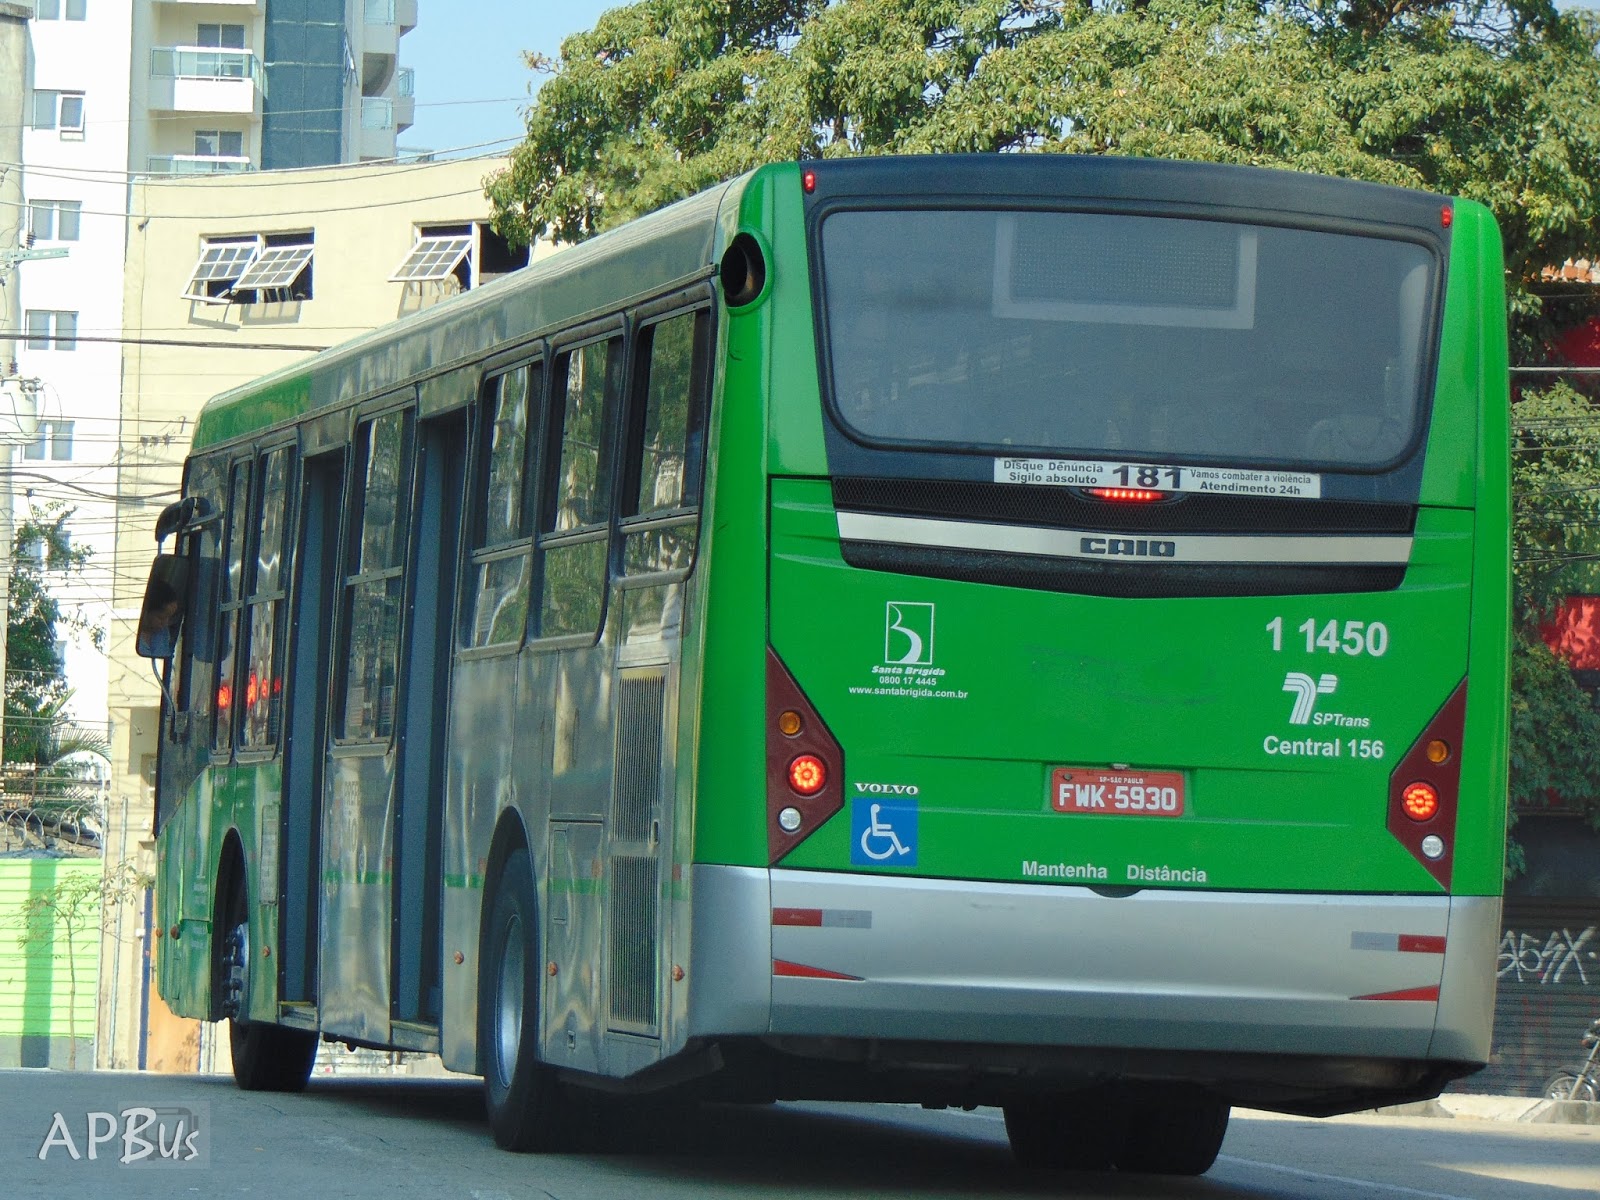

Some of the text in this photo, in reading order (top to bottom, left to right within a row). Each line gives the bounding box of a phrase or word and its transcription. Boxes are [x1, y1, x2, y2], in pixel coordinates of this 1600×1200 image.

[1004, 460, 1104, 473] Disque Denúncia
[1009, 472, 1098, 484] Sigilo absoluto
[1112, 465, 1181, 489] 181
[1190, 469, 1220, 480] Vamos
[1221, 473, 1262, 482] combater
[1200, 481, 1300, 495] Atendimento 24h
[1080, 537, 1175, 557] CAIO
[1266, 616, 1388, 656] 1 1450
[871, 665, 903, 675] Santa
[879, 676, 938, 686] 0800 17 4445
[848, 686, 969, 699] www.santabrigida.com.br
[1312, 712, 1370, 727] SPTrans
[1263, 735, 1385, 758] Central 156
[1123, 777, 1144, 785] PAULO
[854, 782, 919, 795] VOLVO
[1022, 860, 1207, 882] Mantenha Distância
